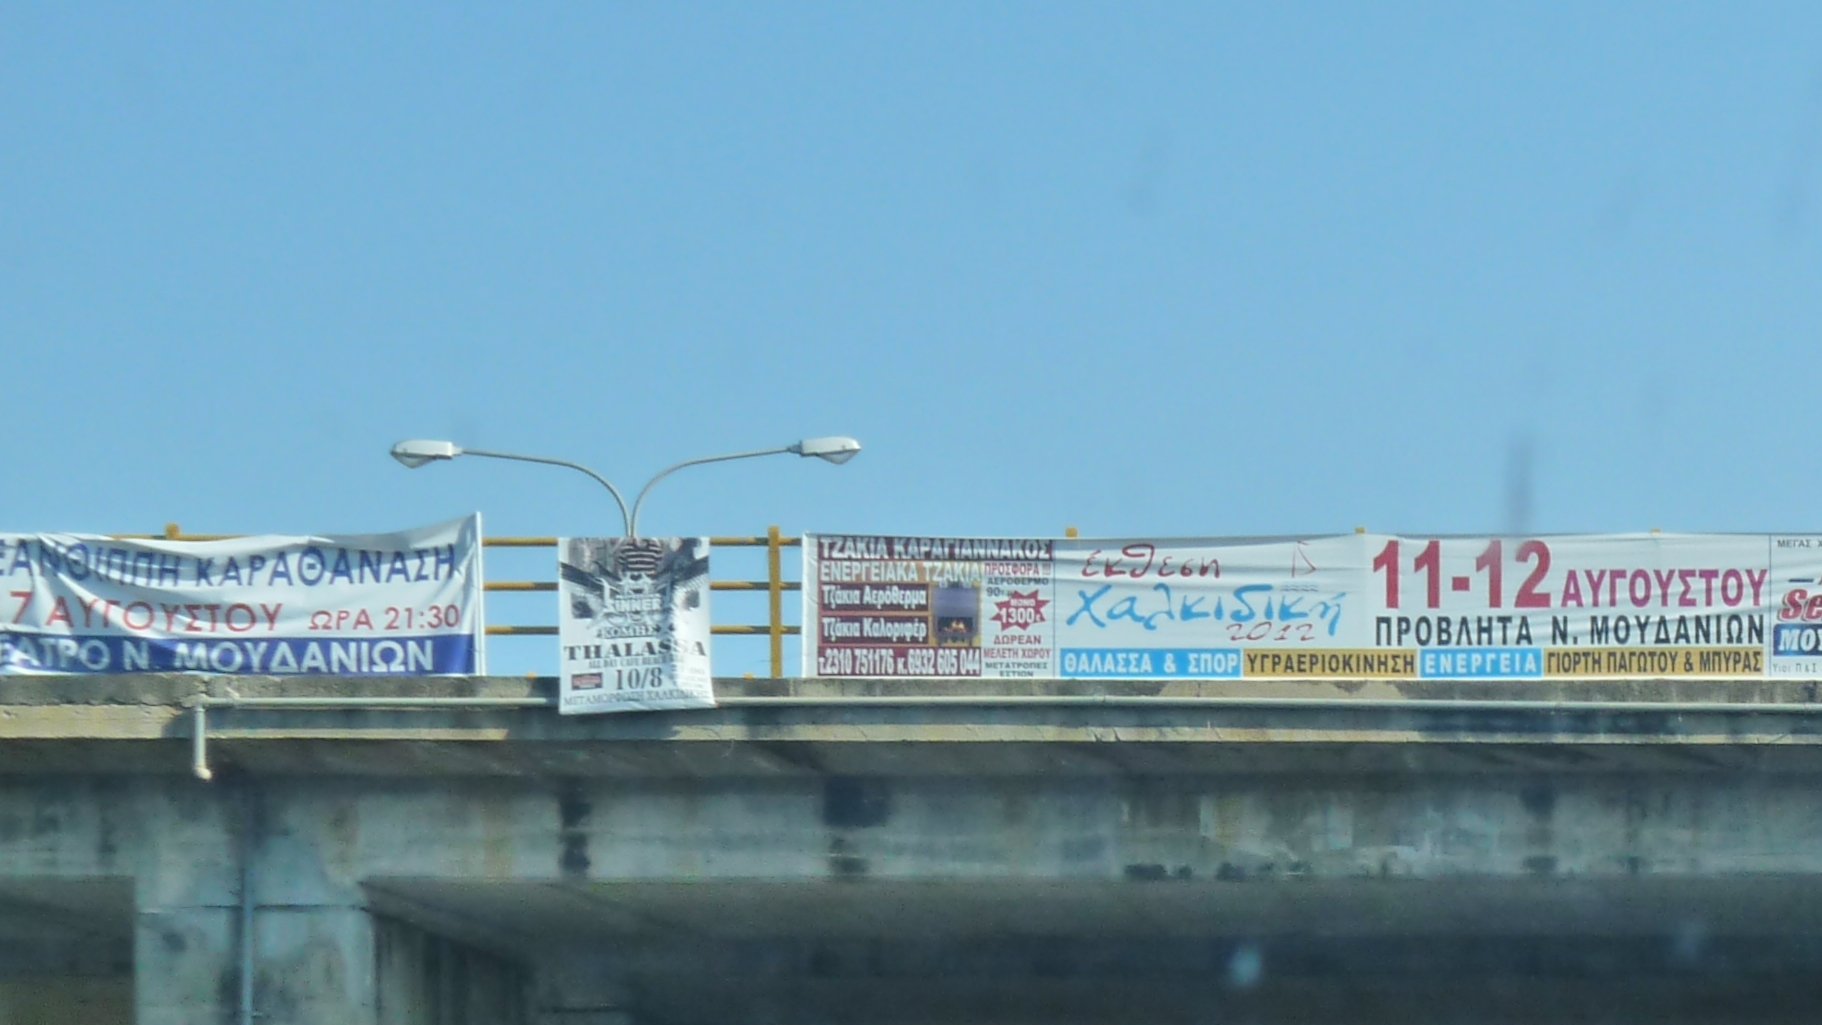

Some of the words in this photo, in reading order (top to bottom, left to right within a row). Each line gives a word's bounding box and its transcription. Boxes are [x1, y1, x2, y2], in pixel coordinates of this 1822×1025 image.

[820, 538, 889, 559] ΤΖΑΚΙΑ
[893, 538, 1050, 560] ΚΑΡΑΓΙΑΝΝΑΚΟΣ
[1777, 539, 1812, 548] ΜΕΓΑΣ
[196, 543, 455, 587] ΚΑΡΑΘΑΝΑΣΗ
[820, 561, 918, 581] ΕΝΕΡΓΕΙΑΚΑ
[923, 561, 983, 582] ΤΖΑΚΙΑ
[984, 562, 1039, 576] ΠΡΟΣΦΟΡΑ
[1373, 540, 1552, 609] 11-12
[822, 585, 860, 606] Τζάκια
[863, 585, 926, 609] Αερόθερμα
[1561, 568, 1769, 609] ΑΥΓΟΥΣΤΟΥ
[46, 595, 283, 633] ΑΥΓΟΥΣΤΟΥ
[308, 609, 374, 630] ΩΡΑ
[384, 604, 460, 630] 21:30
[1066, 583, 1347, 636] Χαλκιδική
[822, 618, 860, 638] Τζάκια
[863, 618, 926, 643] Καλοριφέρ
[993, 635, 1041, 645] ΔΩΡΕΑΝ
[1227, 621, 1315, 641] 2012
[1375, 615, 1533, 647] ΠΡΟΒΛΗΤΑ
[1551, 615, 1578, 646] Ν.
[1590, 613, 1764, 646] ΜΟΥΔΑΝΙΩΝ
[174, 639, 434, 674] ΜΟΥΔΑΝΙΩΝ
[854, 649, 894, 674] 751176
[937, 649, 958, 674] 605
[960, 649, 980, 674] 044
[1064, 652, 1153, 674] ΘΑΛΑΣΣΑ
[1163, 653, 1177, 674] &
[1187, 652, 1238, 674] ΣΠΟΡ
[1246, 653, 1415, 674] ΥΓΡΑΕΡΙΟΚΙΝΗΣΗ
[1425, 655, 1538, 675] ΕΝΕΡΓΕΙΑ
[1546, 651, 1601, 674] ΓΙΟΡΤΗ
[1606, 651, 1678, 674] ΠΑΓΩΤΟΥ
[1683, 651, 1694, 673] &
[1699, 650, 1762, 673] ΜΠΥΡΑΣ
[616, 668, 663, 691] 10/8
